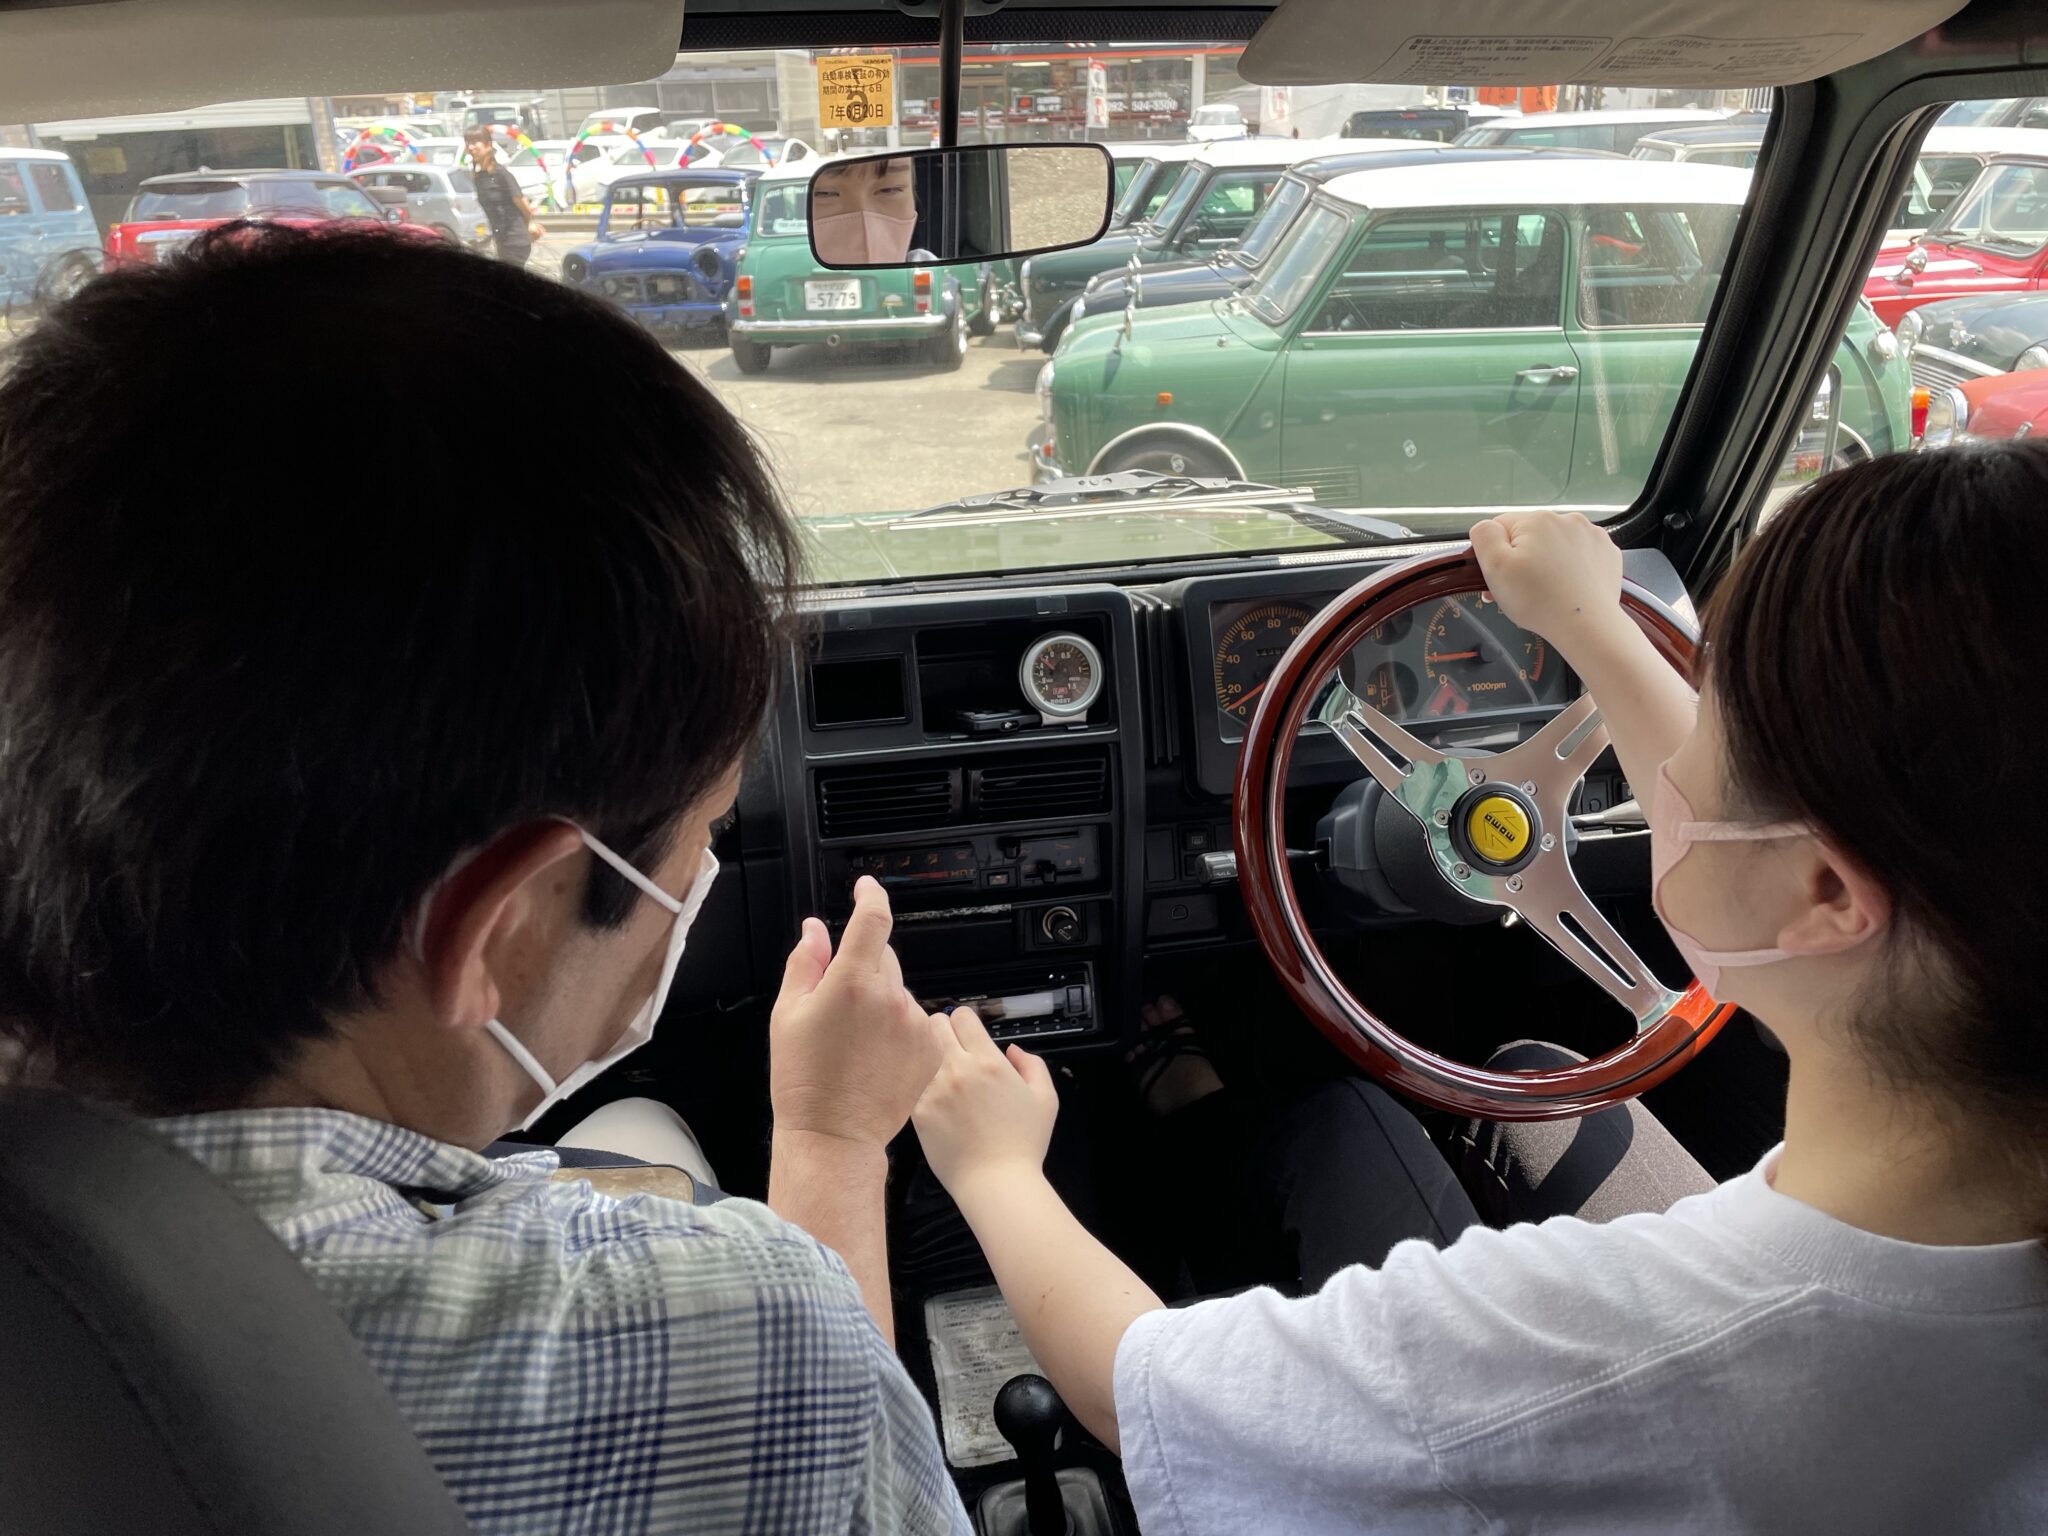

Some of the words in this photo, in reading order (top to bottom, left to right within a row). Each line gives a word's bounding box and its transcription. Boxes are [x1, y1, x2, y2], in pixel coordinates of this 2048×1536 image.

[829, 104, 884, 120] 7年6月20日
[1475, 600, 1483, 610] 4
[1452, 608, 1461, 618] 3
[1267, 619, 1281, 628] 80
[1241, 631, 1255, 640] 60
[1437, 626, 1446, 636] 2
[1524, 643, 1532, 654] 7
[1226, 654, 1240, 664] 40
[1519, 670, 1527, 680] 8
[1228, 684, 1242, 693] 20
[1238, 706, 1246, 715] 0
